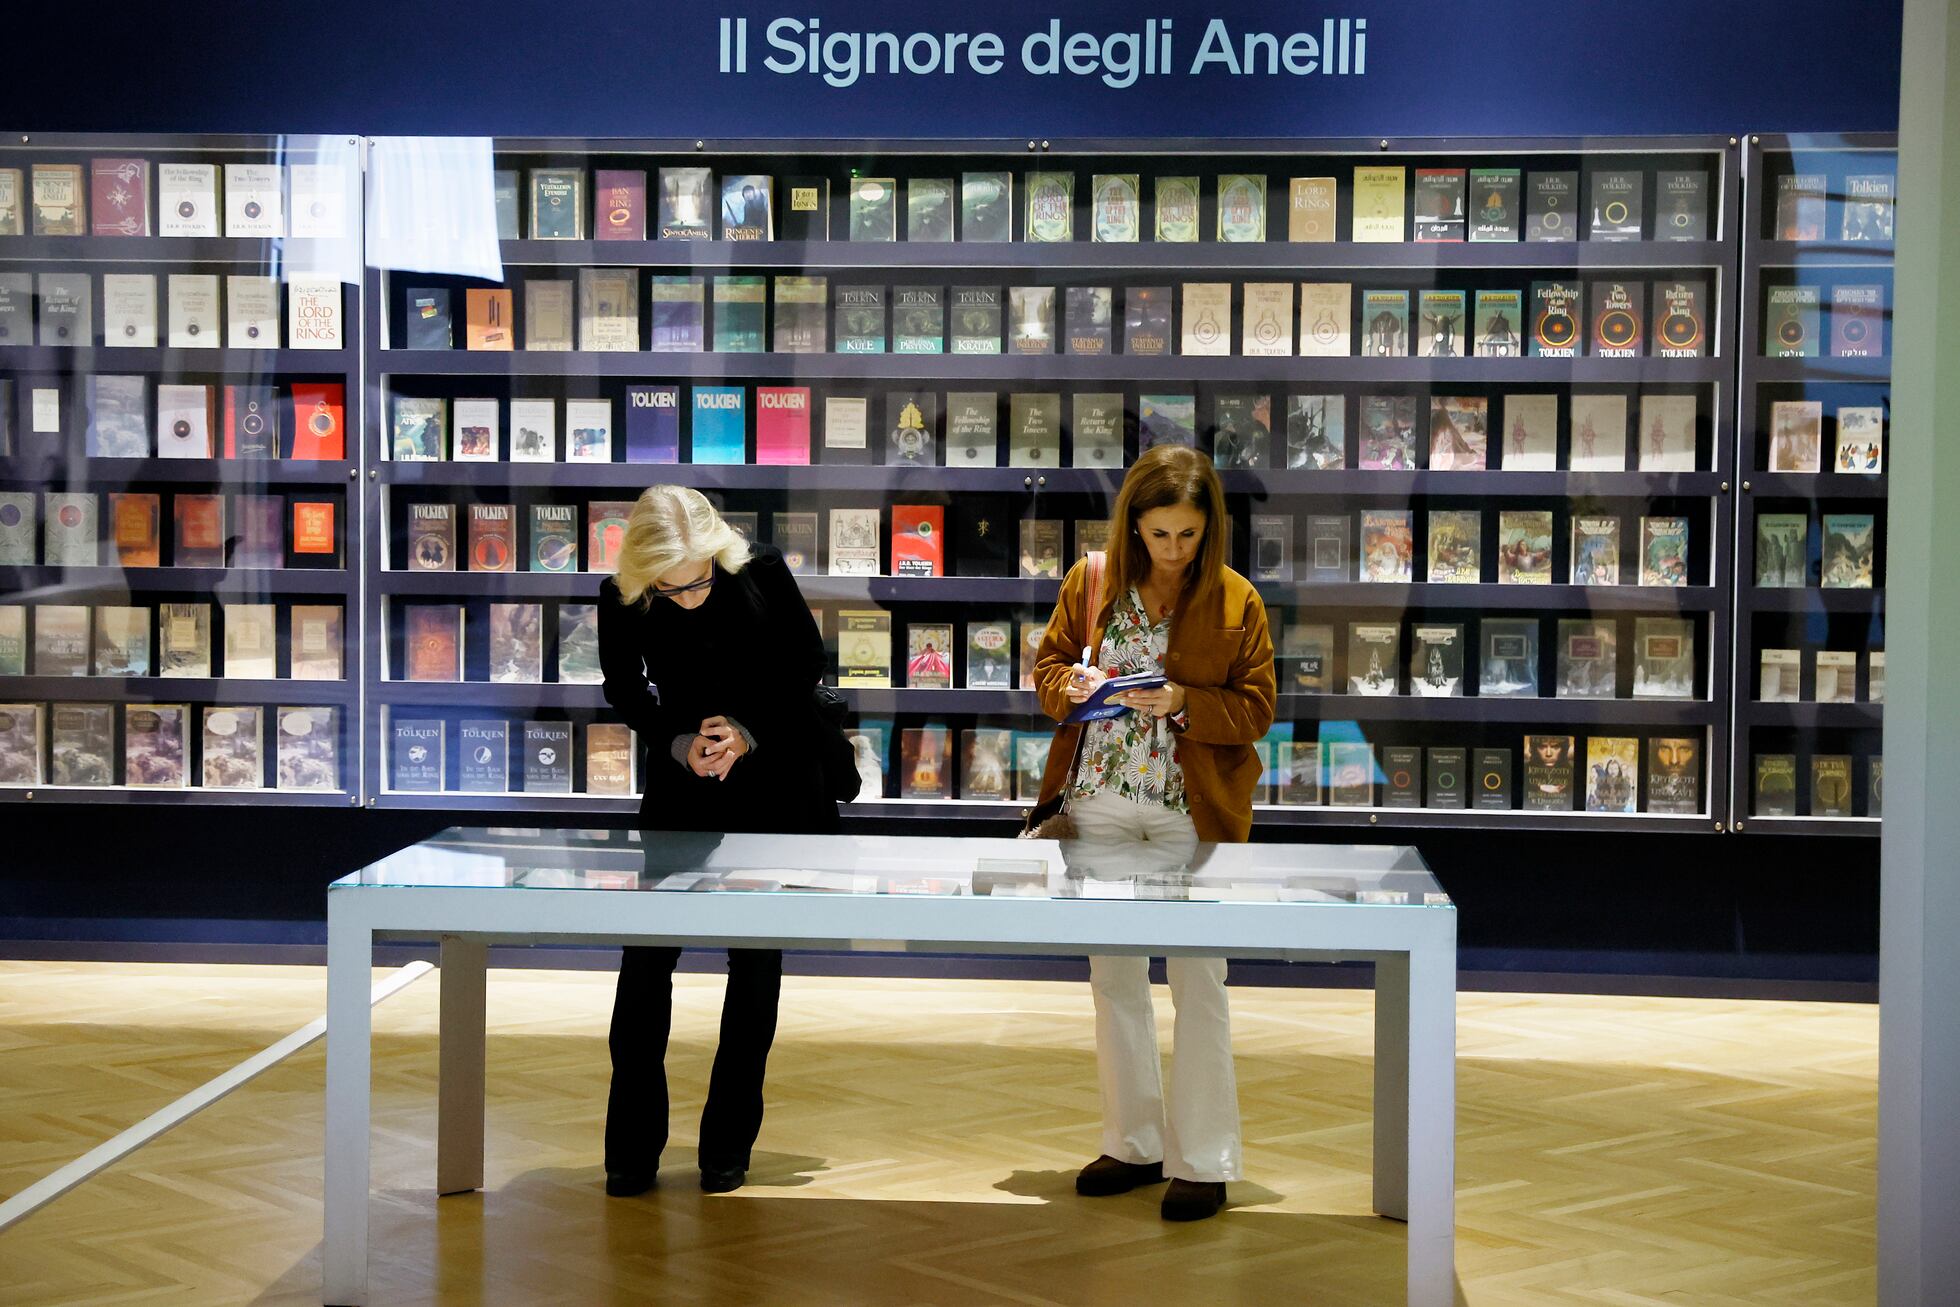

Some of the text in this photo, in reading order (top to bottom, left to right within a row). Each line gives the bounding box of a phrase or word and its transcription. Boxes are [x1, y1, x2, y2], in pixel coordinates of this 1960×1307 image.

[719, 17, 1367, 88] Il Signore degli Anelli
[1297, 184, 1327, 196] LORD
[1667, 182, 1698, 190] TOLKIEN
[1850, 179, 1889, 193] Tolkien
[609, 199, 631, 208] RING
[1294, 196, 1330, 209] RINGS
[1035, 211, 1067, 221] RINGS
[1537, 289, 1579, 299] Fellowship
[1611, 290, 1627, 301] Two
[1665, 289, 1694, 299] Return
[299, 296, 318, 307] THE
[1604, 300, 1632, 310] Towers
[60, 304, 78, 313] King
[297, 306, 333, 318] LORD
[1548, 305, 1567, 317] Ring
[1670, 305, 1690, 317] King
[298, 318, 333, 328] OF THE
[296, 328, 336, 340] RINGS
[846, 340, 874, 351] KULE
[1538, 348, 1575, 358] TOLKIEN
[1598, 348, 1635, 358] TOLKIEN
[1660, 348, 1698, 358] TOLKIEN
[631, 391, 676, 408] TOLKIEN
[695, 393, 741, 409] TOLKIEN
[759, 393, 805, 409] TOLKIEN
[965, 407, 978, 415] The
[1028, 407, 1042, 416] The
[1092, 407, 1105, 417] The
[954, 415, 991, 425] Fellowship
[1028, 417, 1043, 425] Two
[1080, 416, 1116, 426] Return of
[952, 425, 960, 434] of
[973, 425, 991, 434] Ring
[1023, 425, 1048, 434] Towers
[1083, 425, 1112, 435] the King
[414, 505, 449, 520] TOLKIEN
[473, 506, 509, 520] TOLKIEN
[535, 507, 571, 521] TOLKIEN
[396, 728, 440, 739] TOLKIEN
[462, 728, 505, 740] TOLKIEN
[526, 730, 568, 741] TOLKIEN
